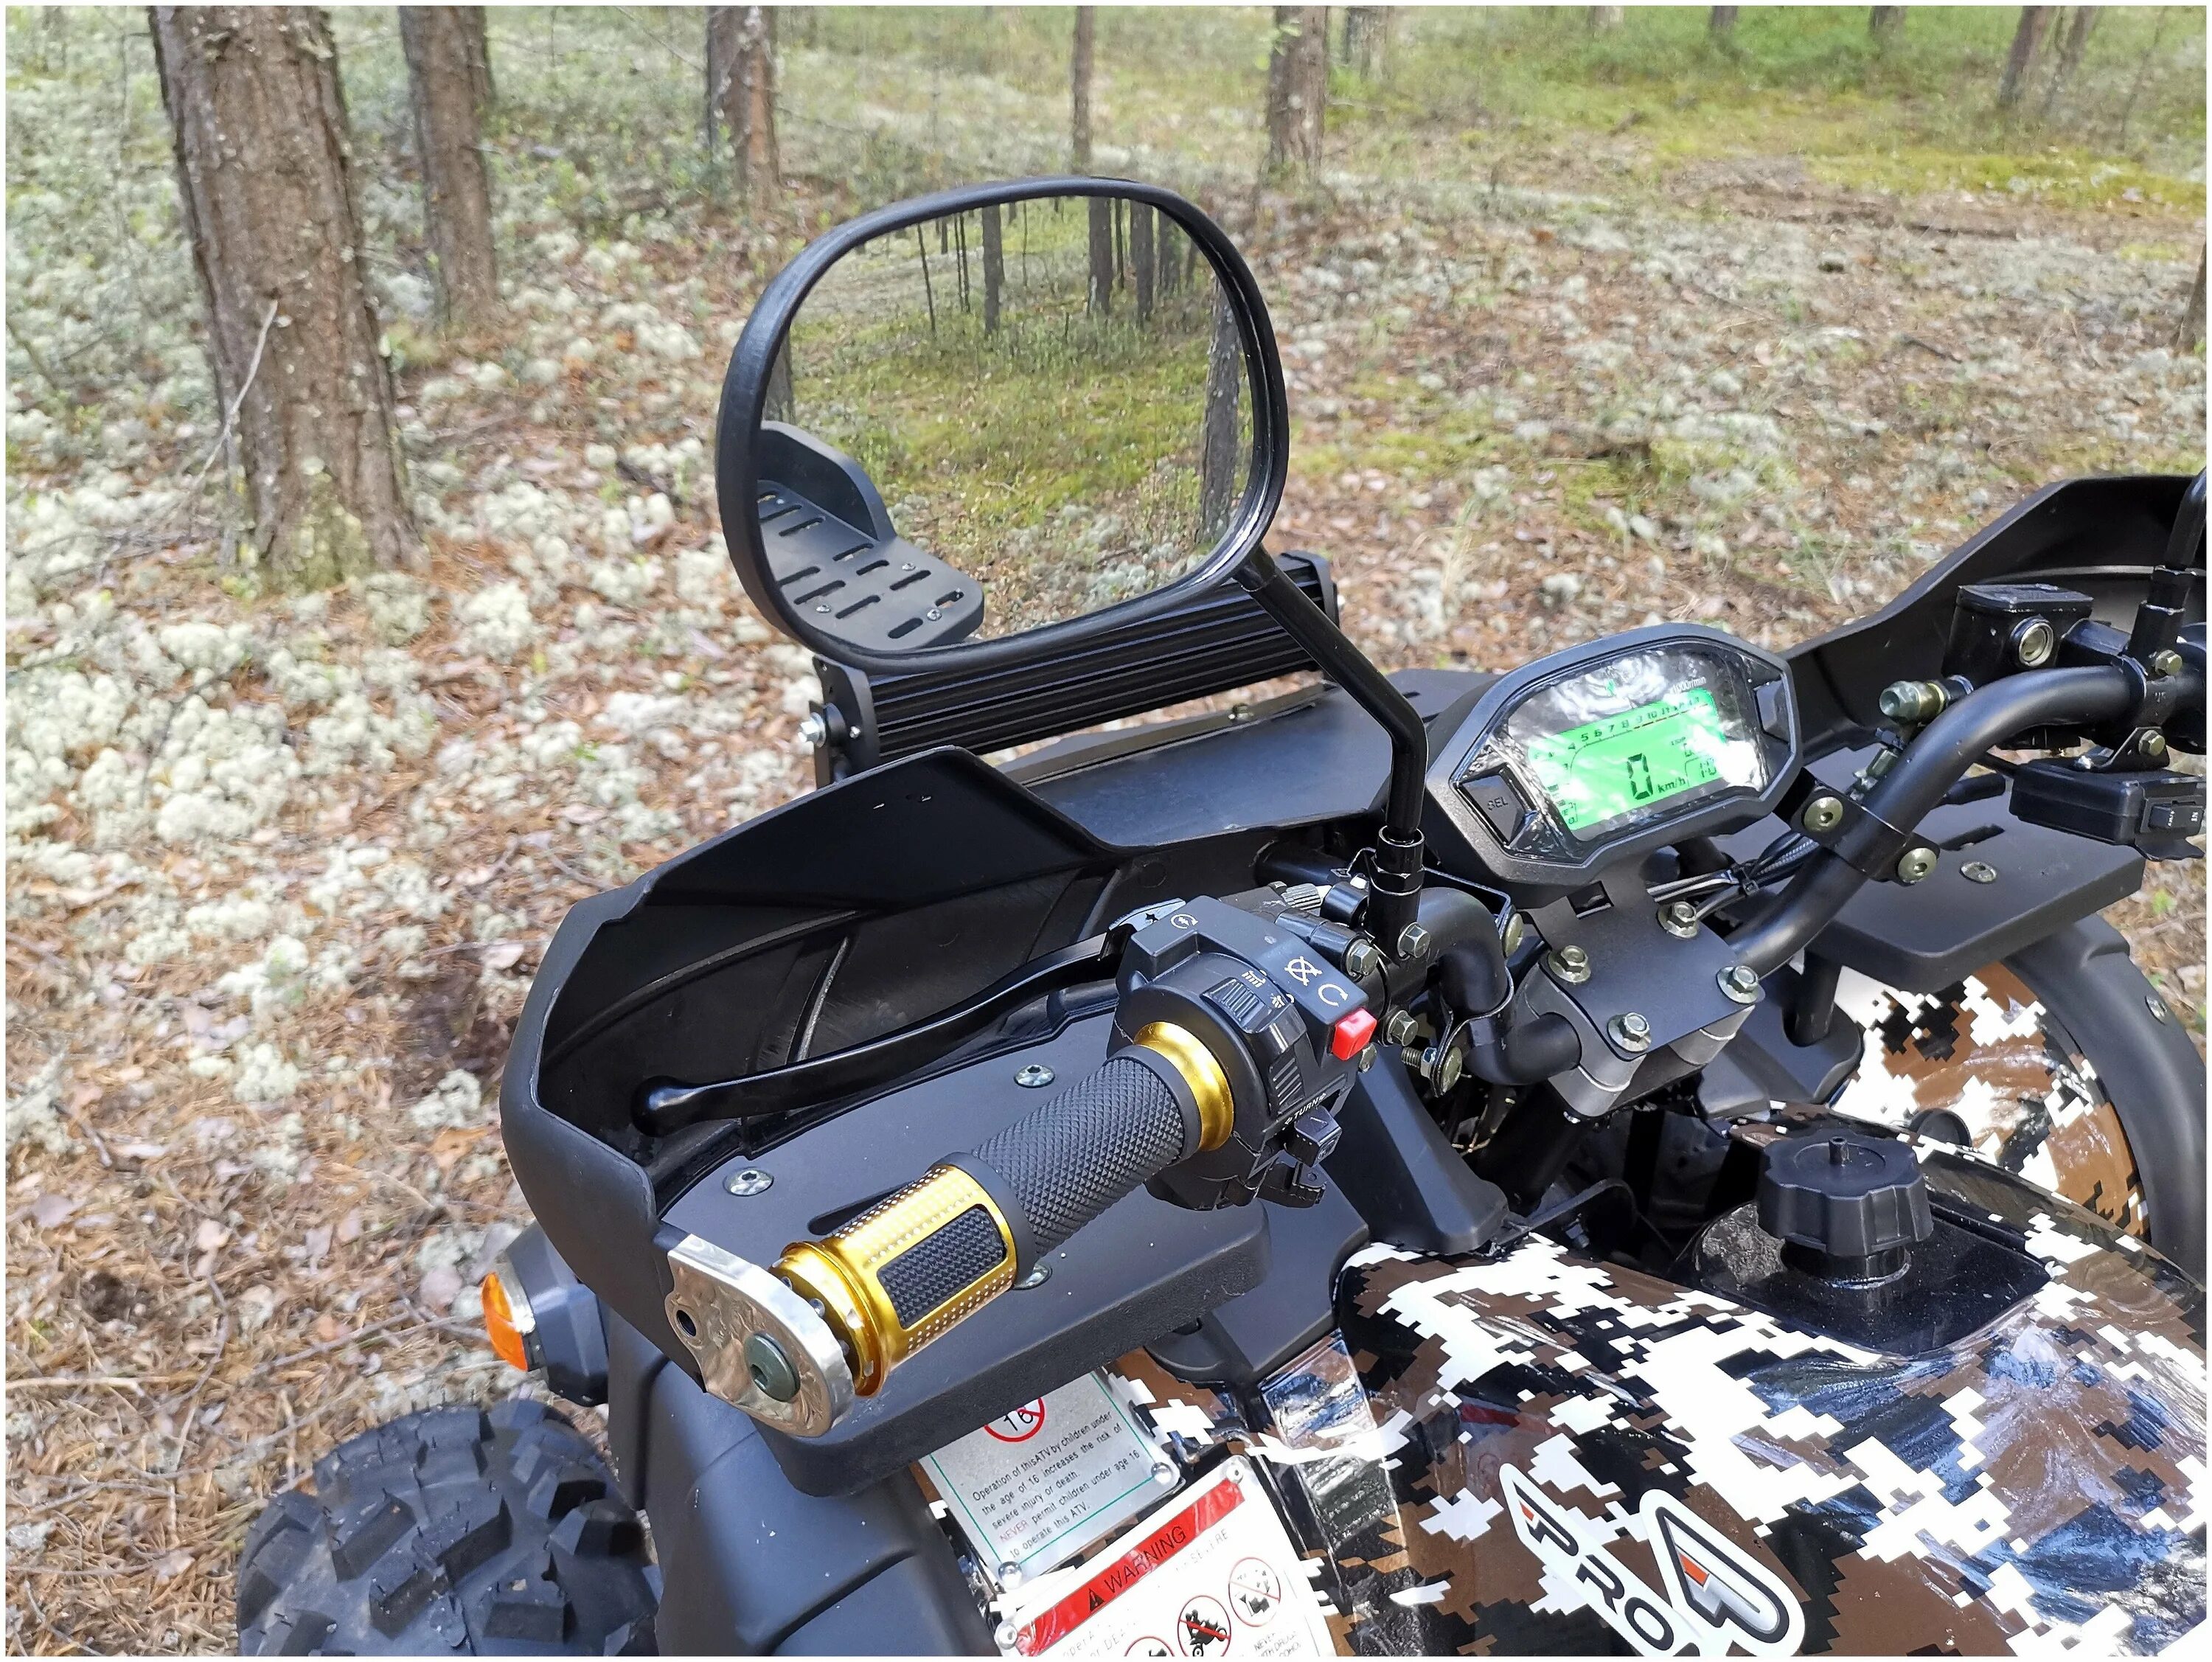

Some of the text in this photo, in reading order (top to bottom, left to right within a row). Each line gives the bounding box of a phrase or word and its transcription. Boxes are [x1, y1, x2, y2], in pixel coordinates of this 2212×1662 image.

[1580, 732, 1589, 743] 5
[1607, 723, 1615, 734] 7
[1487, 796, 1509, 811] SEL
[1627, 752, 1654, 801] 0
[1658, 776, 1686, 794] km/h
[1294, 1096, 1319, 1119] TURN
[1004, 1406, 1034, 1432] 16
[973, 1475, 1013, 1501] Operation
[1012, 1466, 1022, 1478] of
[1050, 1442, 1062, 1454] by
[1061, 1424, 1091, 1447] children
[1091, 1411, 1113, 1429] under
[981, 1423, 1123, 1516] the age of 16 increases the risk of
[992, 1470, 1081, 1530] severe injury or death.
[999, 1449, 1141, 1544] NEVER permit children under age 16
[1009, 1501, 1091, 1560] to operate this ATV.
[1104, 1524, 1187, 1593] WARNING
